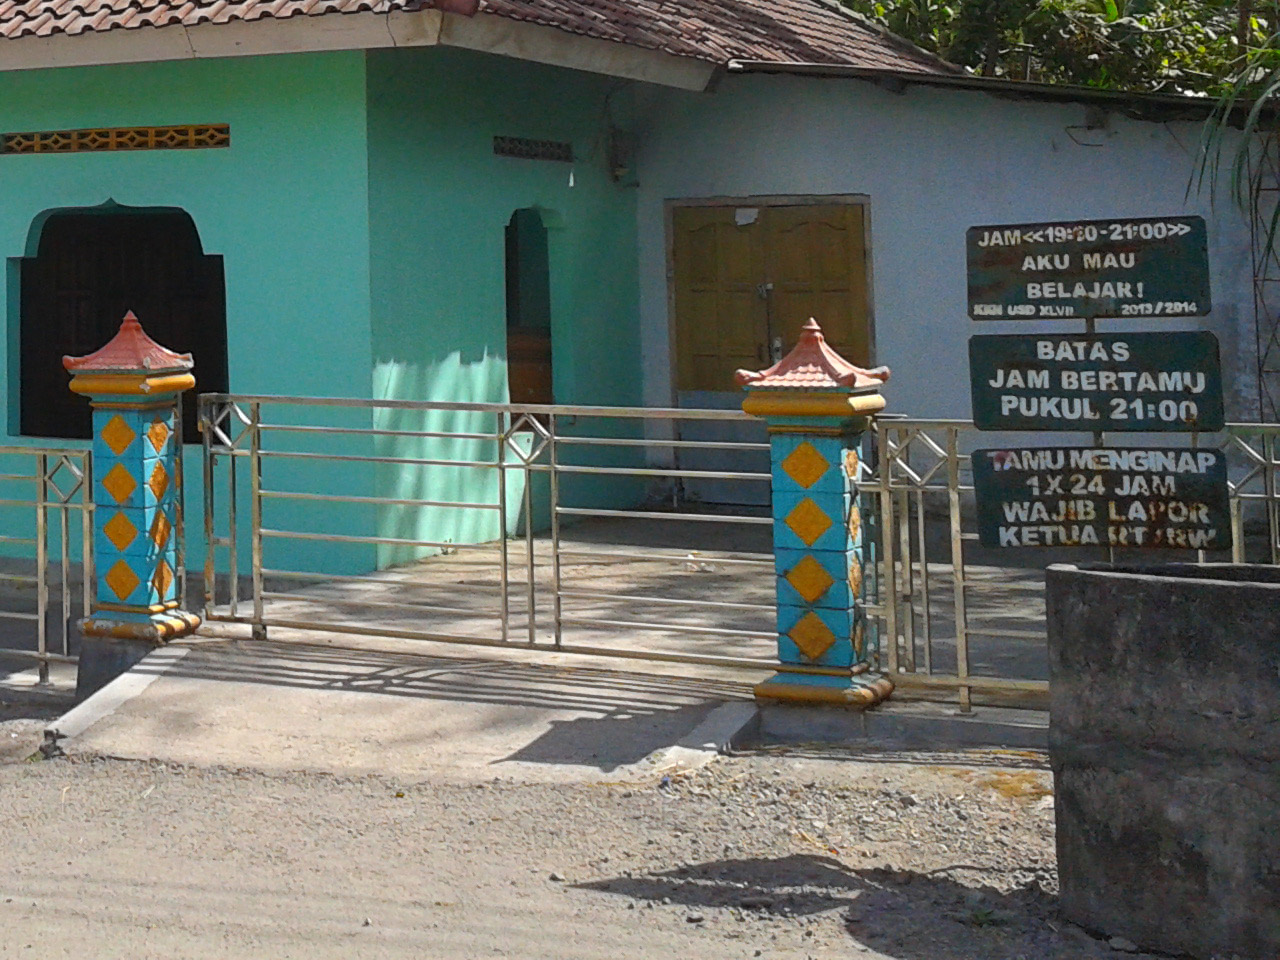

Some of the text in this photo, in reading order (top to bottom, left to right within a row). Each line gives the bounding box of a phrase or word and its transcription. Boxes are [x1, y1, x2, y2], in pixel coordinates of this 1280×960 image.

[978, 230, 1021, 247] JAM
[1022, 252, 1136, 271] AKU MAU
[1036, 340, 1130, 362] BATAS
[989, 369, 1206, 394] JAM BERTAMU
[1001, 395, 1198, 422] PUKUL 21:00
[987, 450, 1217, 474] TAMU MENGINAP
[1070, 474, 1106, 496] 24
[1114, 475, 1176, 497] JAM
[1002, 500, 1211, 524] WAJIB LAPOR
[998, 525, 1100, 548] KETUA
